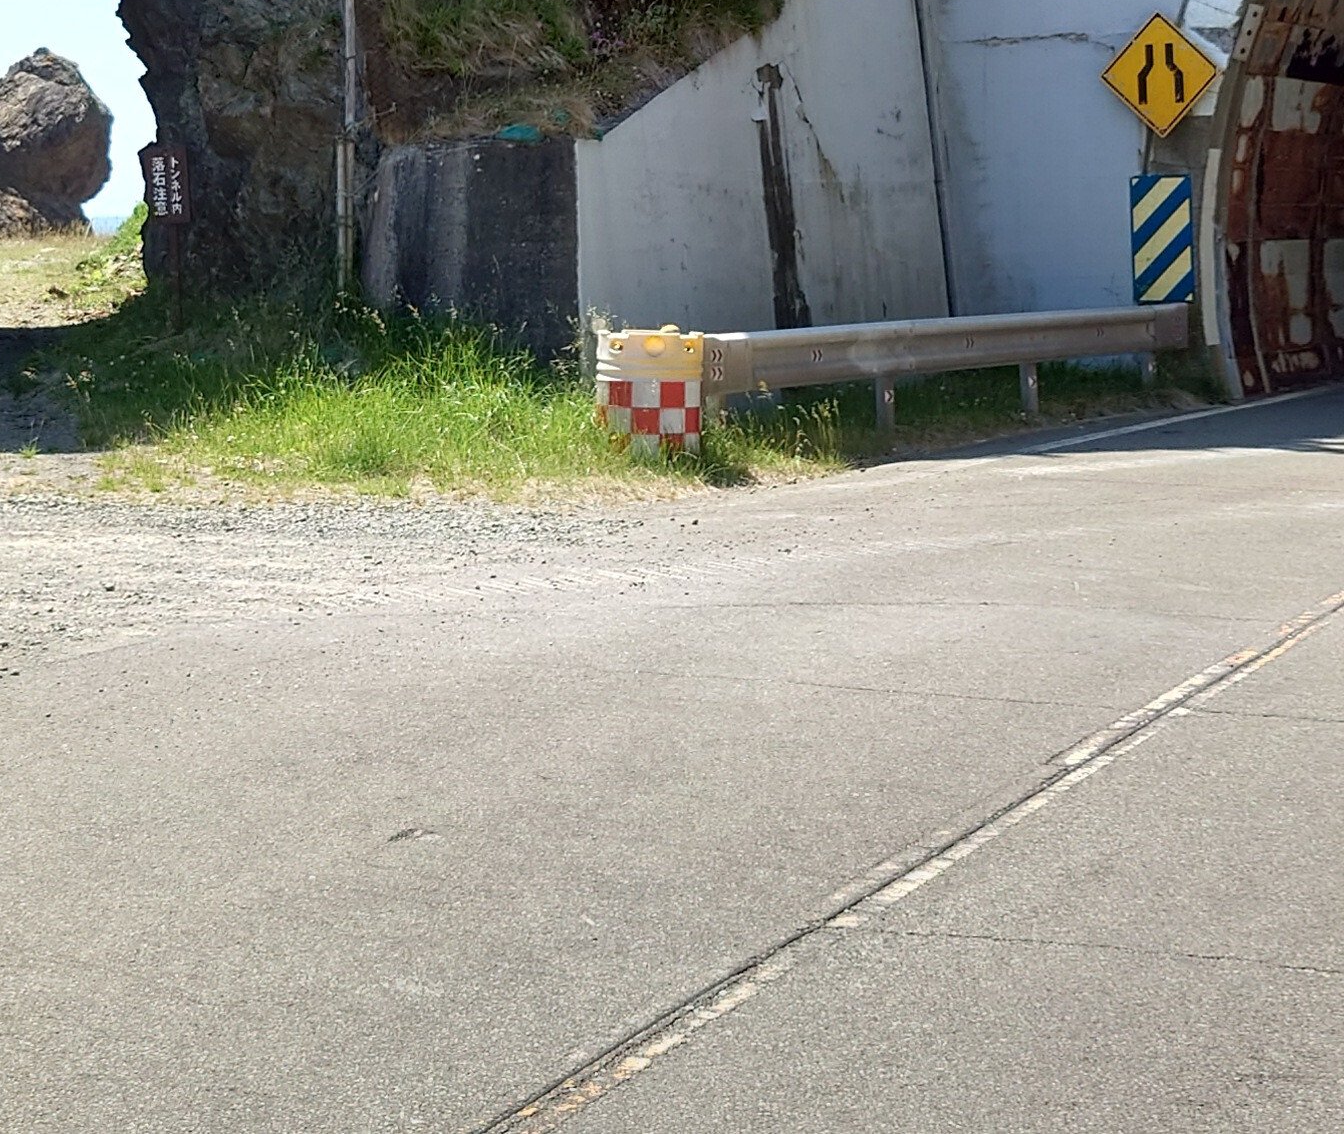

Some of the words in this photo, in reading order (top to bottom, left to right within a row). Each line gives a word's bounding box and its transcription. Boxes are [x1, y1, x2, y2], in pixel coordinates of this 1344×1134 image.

[152, 156, 168, 216] 落石注意
[170, 156, 182, 215] トンネル内
